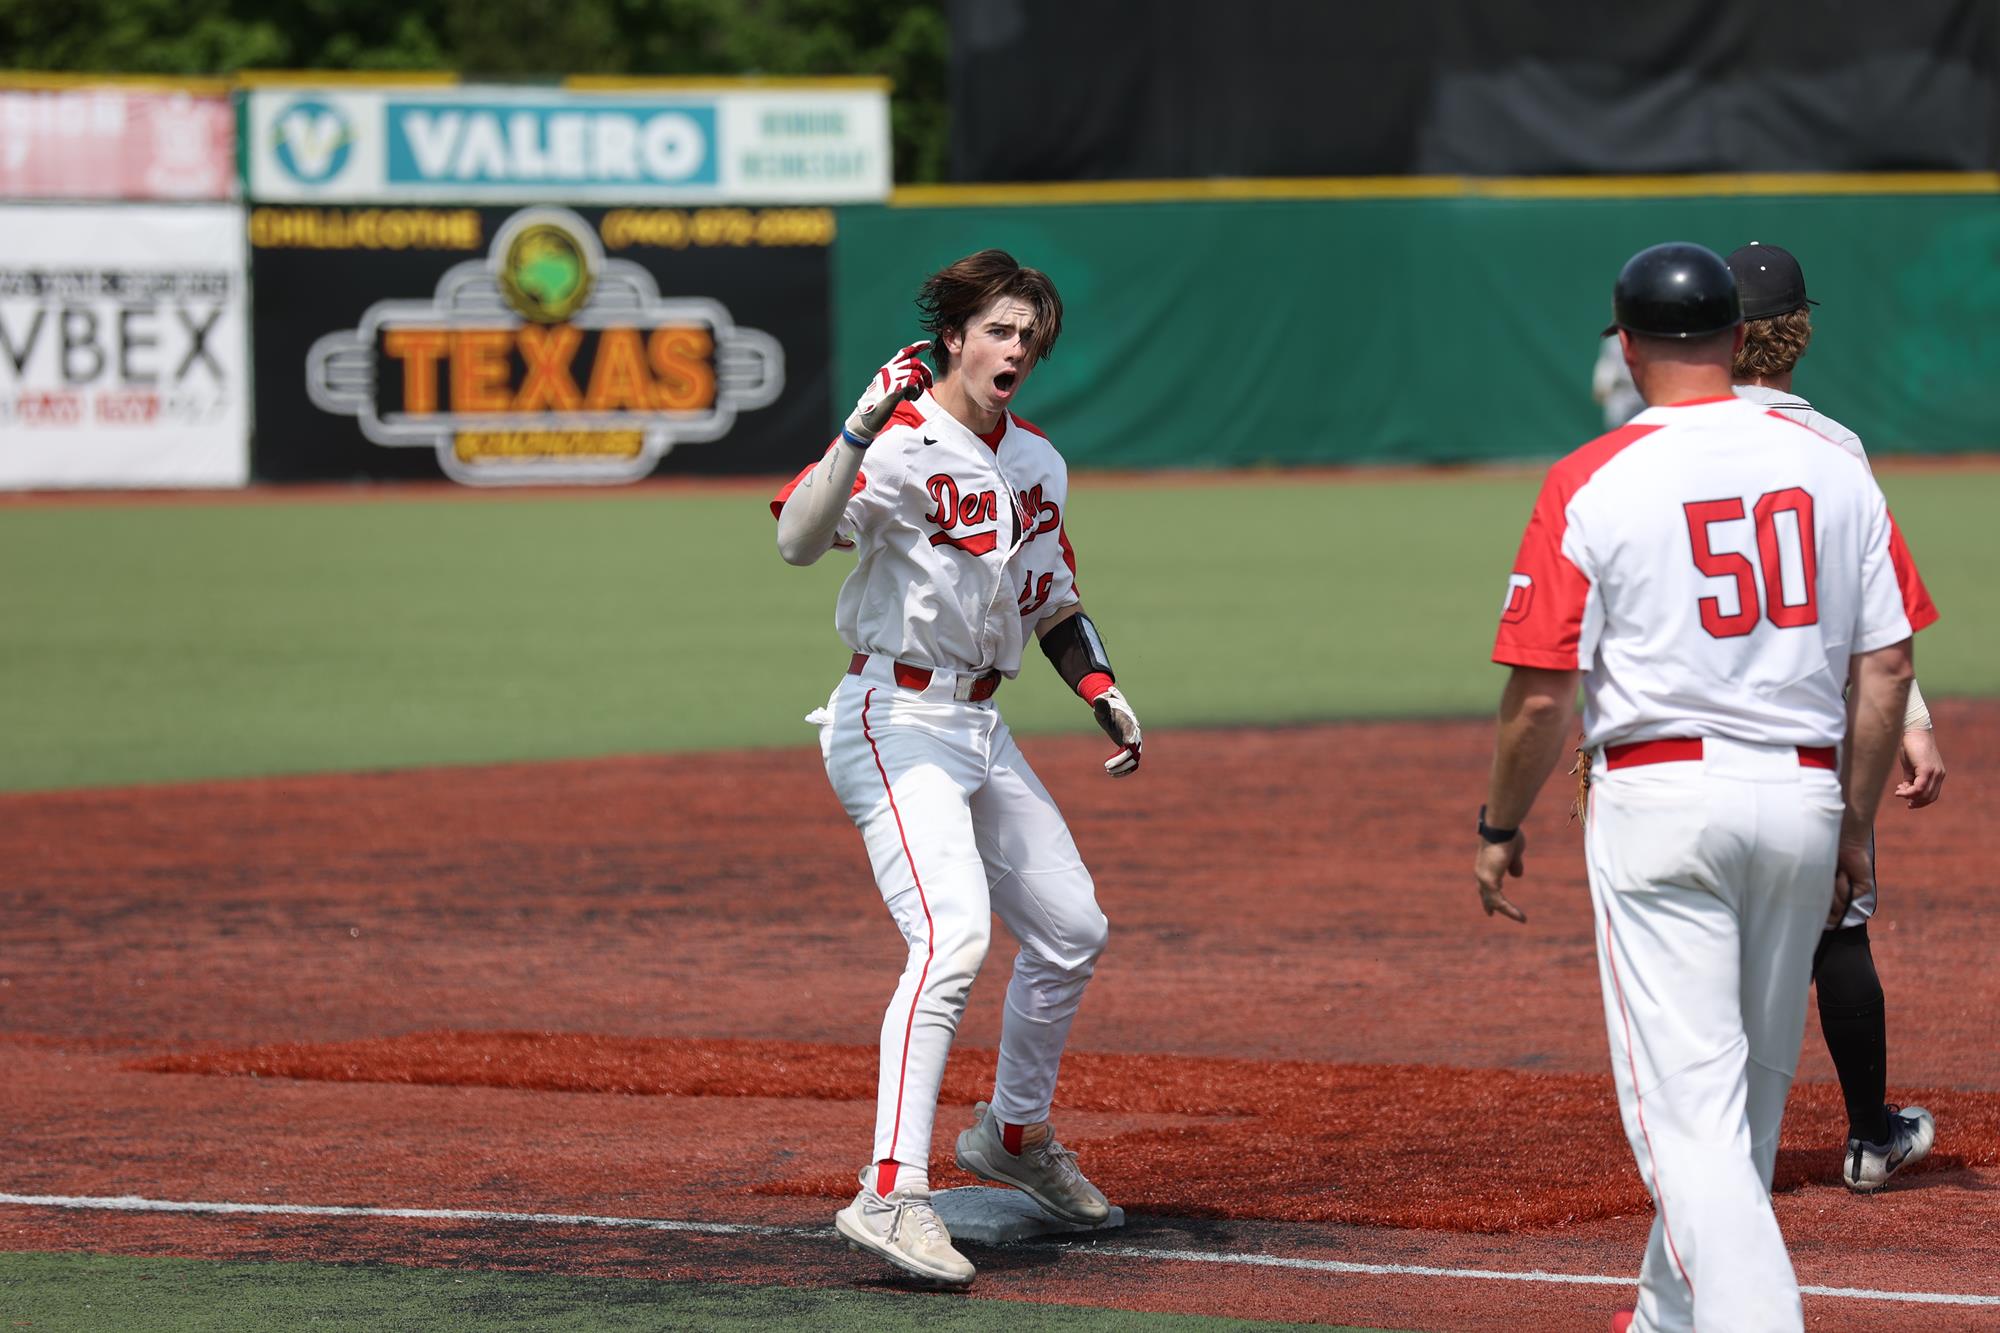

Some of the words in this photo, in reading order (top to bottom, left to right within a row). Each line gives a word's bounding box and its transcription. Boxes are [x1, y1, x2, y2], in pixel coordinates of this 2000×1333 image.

[402, 109, 707, 180] VALERO
[250, 209, 481, 249] CHILLICOTHE
[384, 324, 716, 414] TEXAS
[1682, 487, 1818, 639] 50
